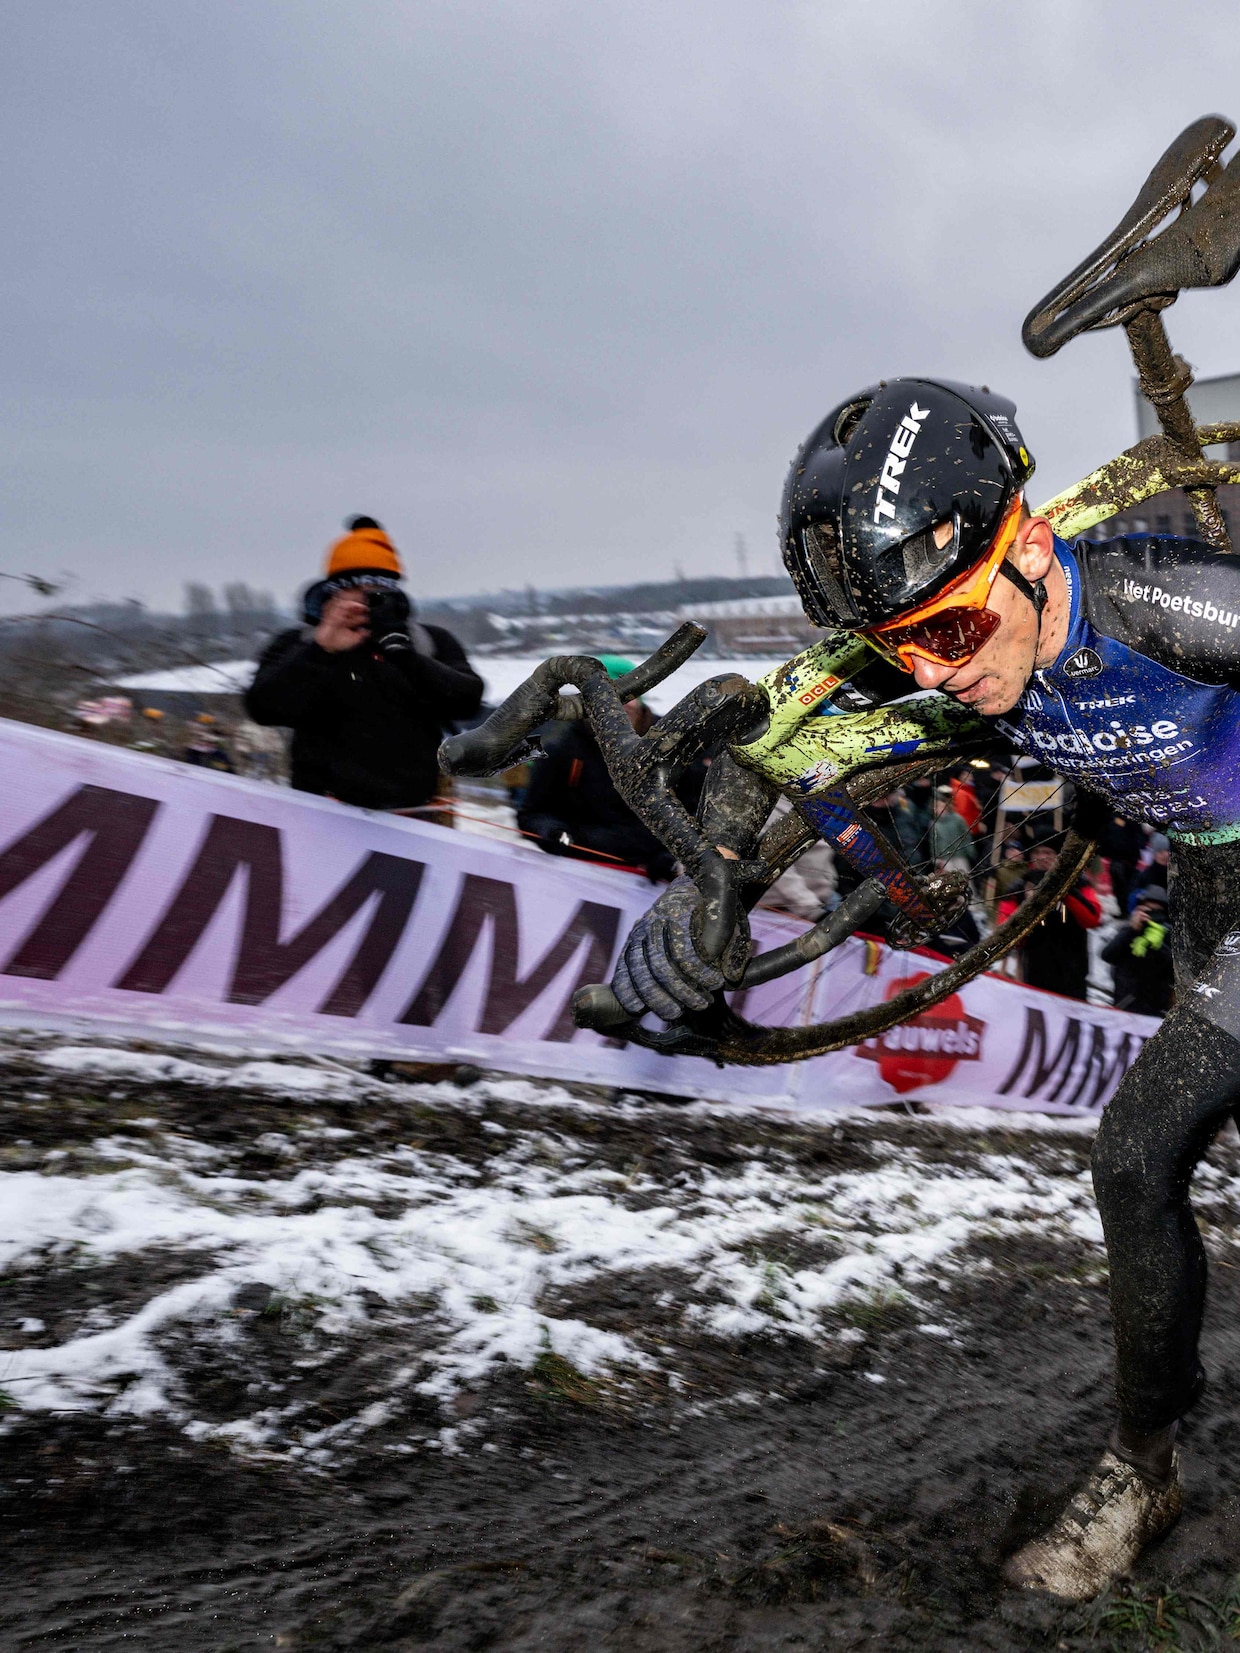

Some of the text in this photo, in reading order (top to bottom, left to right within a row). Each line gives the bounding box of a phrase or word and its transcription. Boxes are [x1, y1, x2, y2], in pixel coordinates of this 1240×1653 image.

[873, 401, 931, 525] TREK
[1123, 578, 1151, 602] Het
[1070, 665, 1099, 677] vermarc
[1075, 695, 1136, 711] TREK
[1026, 720, 1180, 756] baloise
[863, 1020, 980, 1055] auwels
